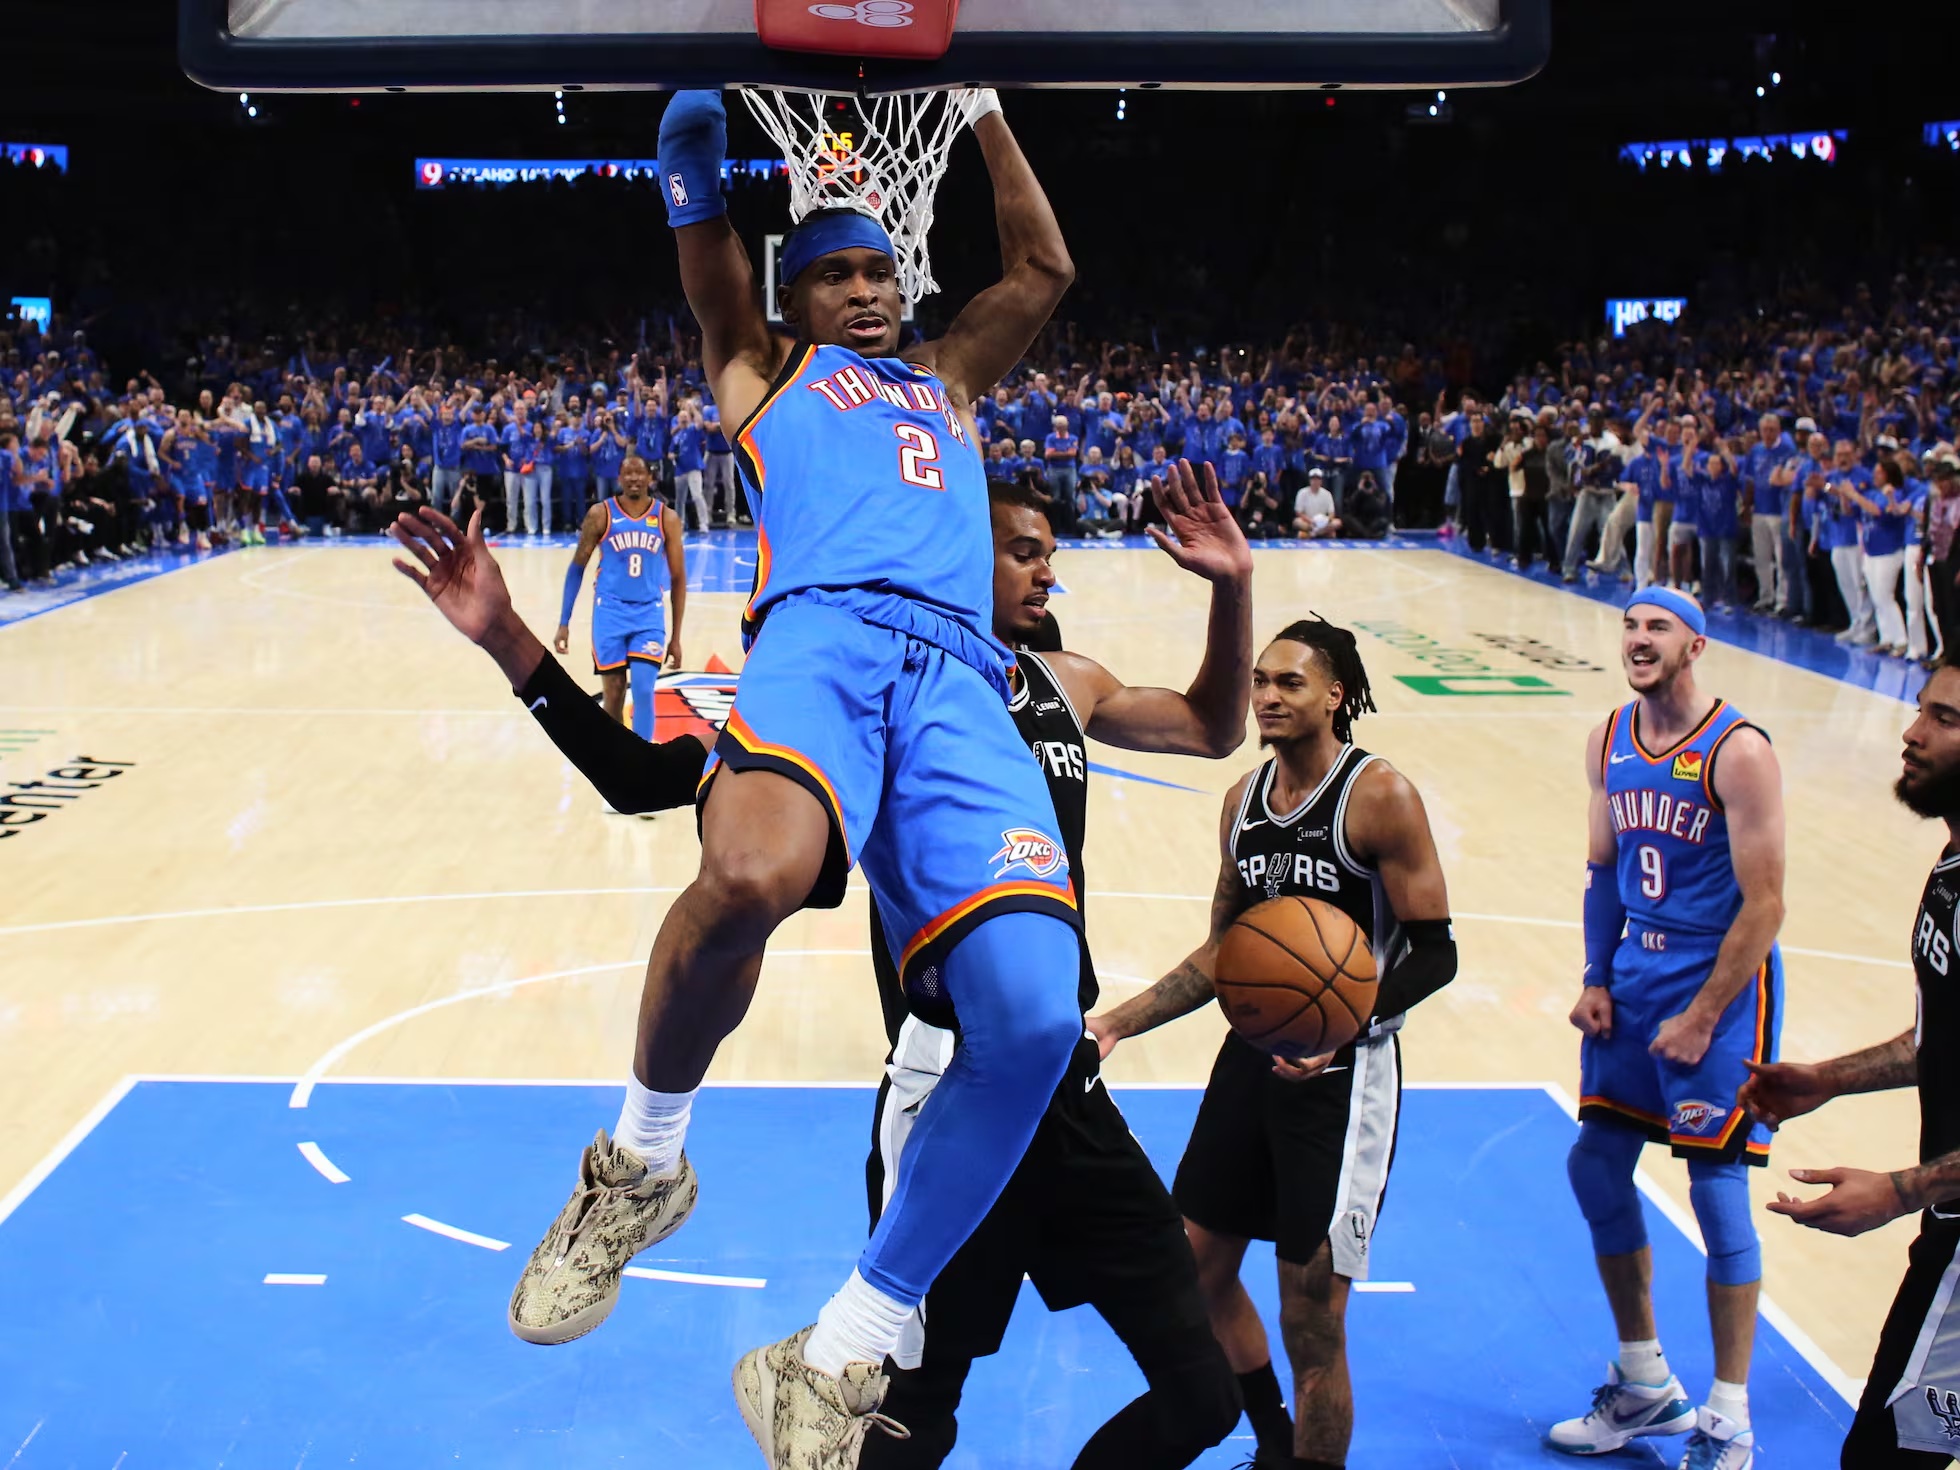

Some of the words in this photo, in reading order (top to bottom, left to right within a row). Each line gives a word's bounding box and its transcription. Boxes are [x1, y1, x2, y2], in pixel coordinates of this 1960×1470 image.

[423, 162, 443, 186] 9
[894, 423, 946, 491] 2
[608, 531, 662, 554] THUNDER
[628, 553, 643, 578] 8
[0, 756, 137, 840] enter
[1301, 829, 1324, 839] LEDGER
[1008, 840, 1053, 861] OKC
[1638, 845, 1664, 899] 9
[1640, 931, 1666, 950] OKC
[1679, 1107, 1705, 1124] OKC
